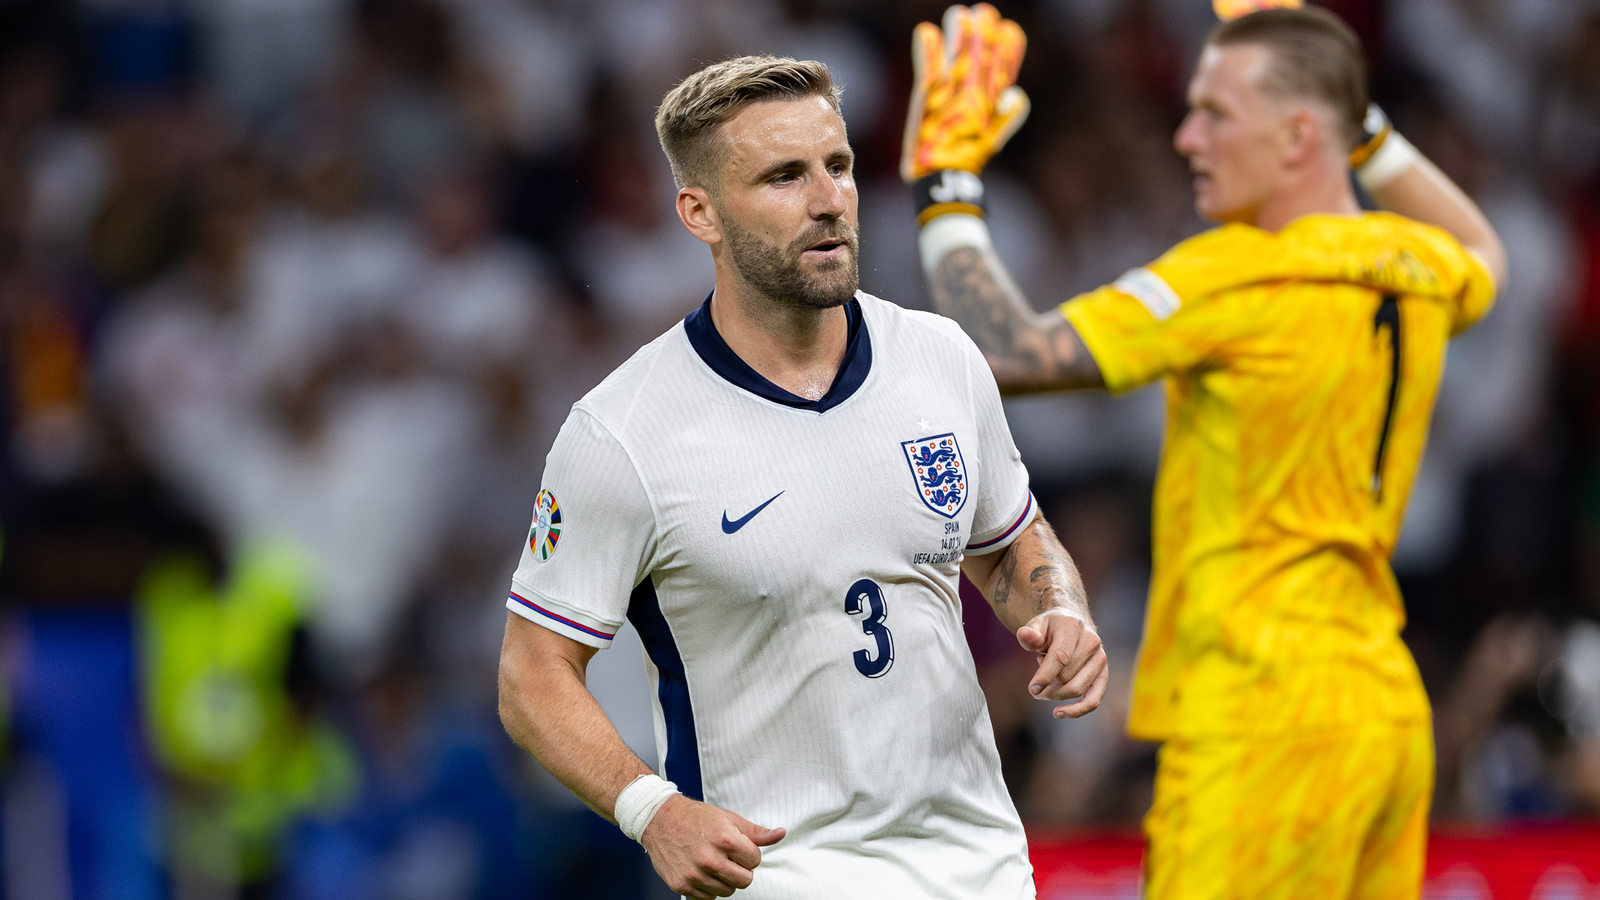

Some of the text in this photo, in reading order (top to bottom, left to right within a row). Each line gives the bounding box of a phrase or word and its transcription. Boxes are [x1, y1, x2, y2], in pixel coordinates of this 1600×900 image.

[1374, 293, 1400, 502] 1
[944, 521, 960, 535] SPAIN
[913, 553, 931, 564] UEFA
[931, 552, 949, 564] EURO
[845, 578, 895, 679] 3
